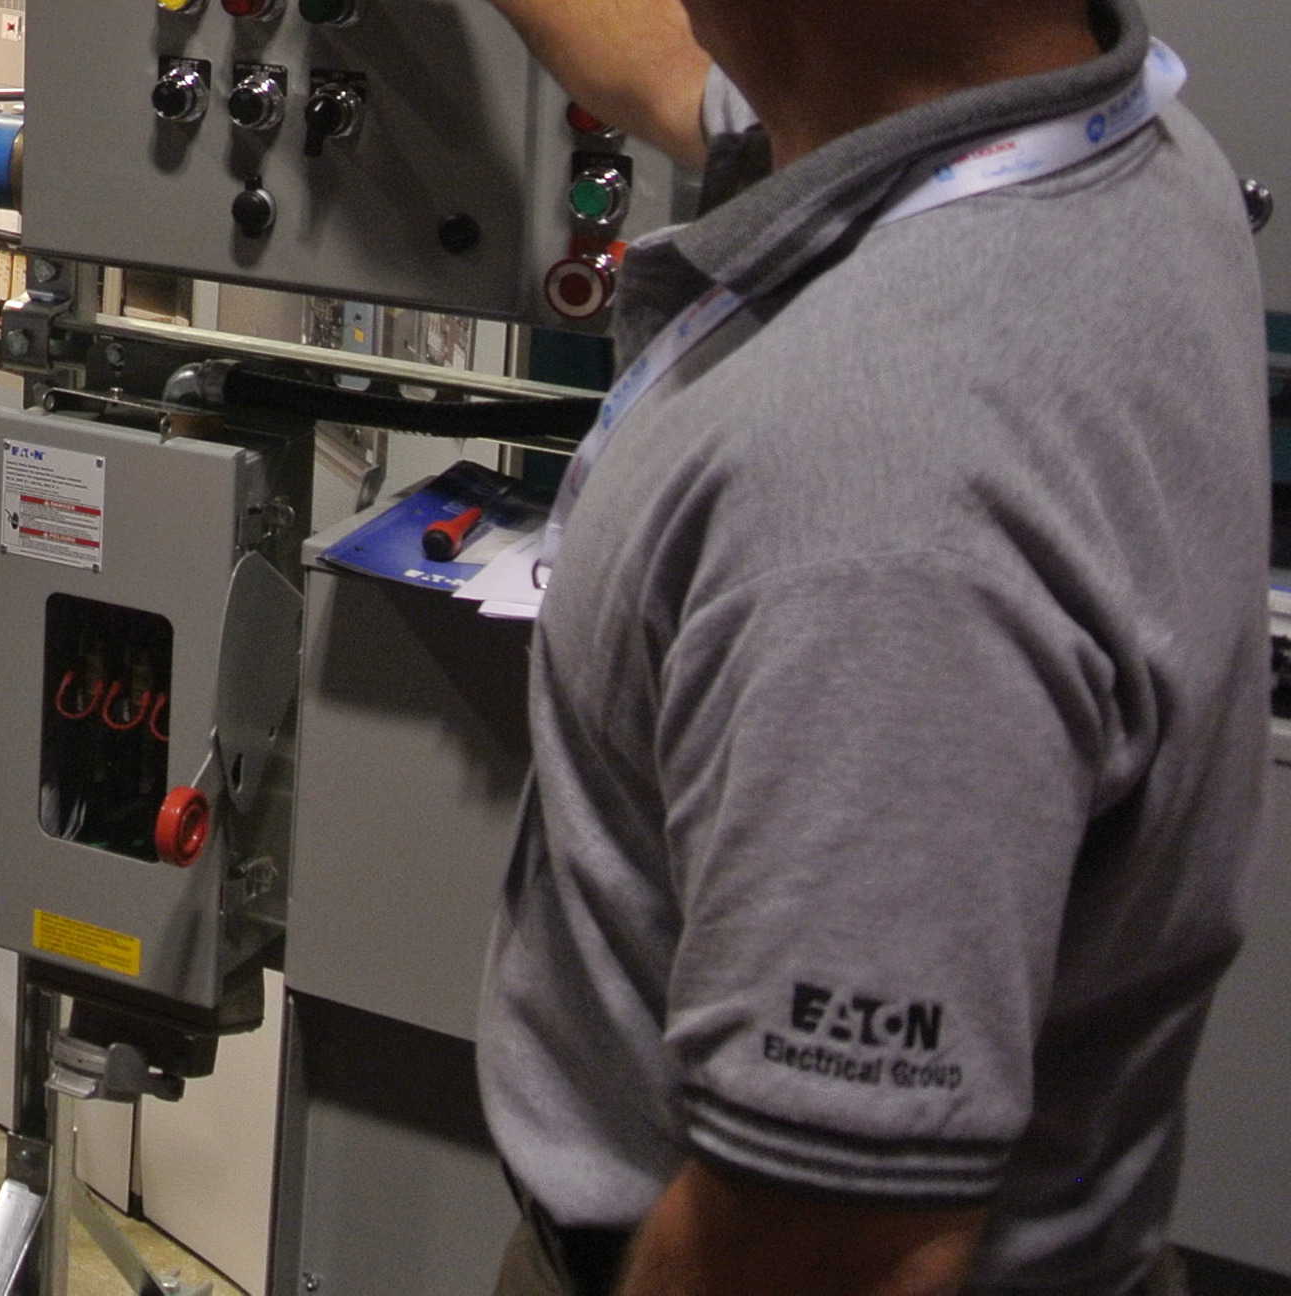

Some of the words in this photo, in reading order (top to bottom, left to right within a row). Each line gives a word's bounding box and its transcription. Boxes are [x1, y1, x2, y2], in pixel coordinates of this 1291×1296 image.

[792, 982, 943, 1050] EATON
[764, 1031, 884, 1085] Electrical
[890, 1058, 963, 1092] Group
